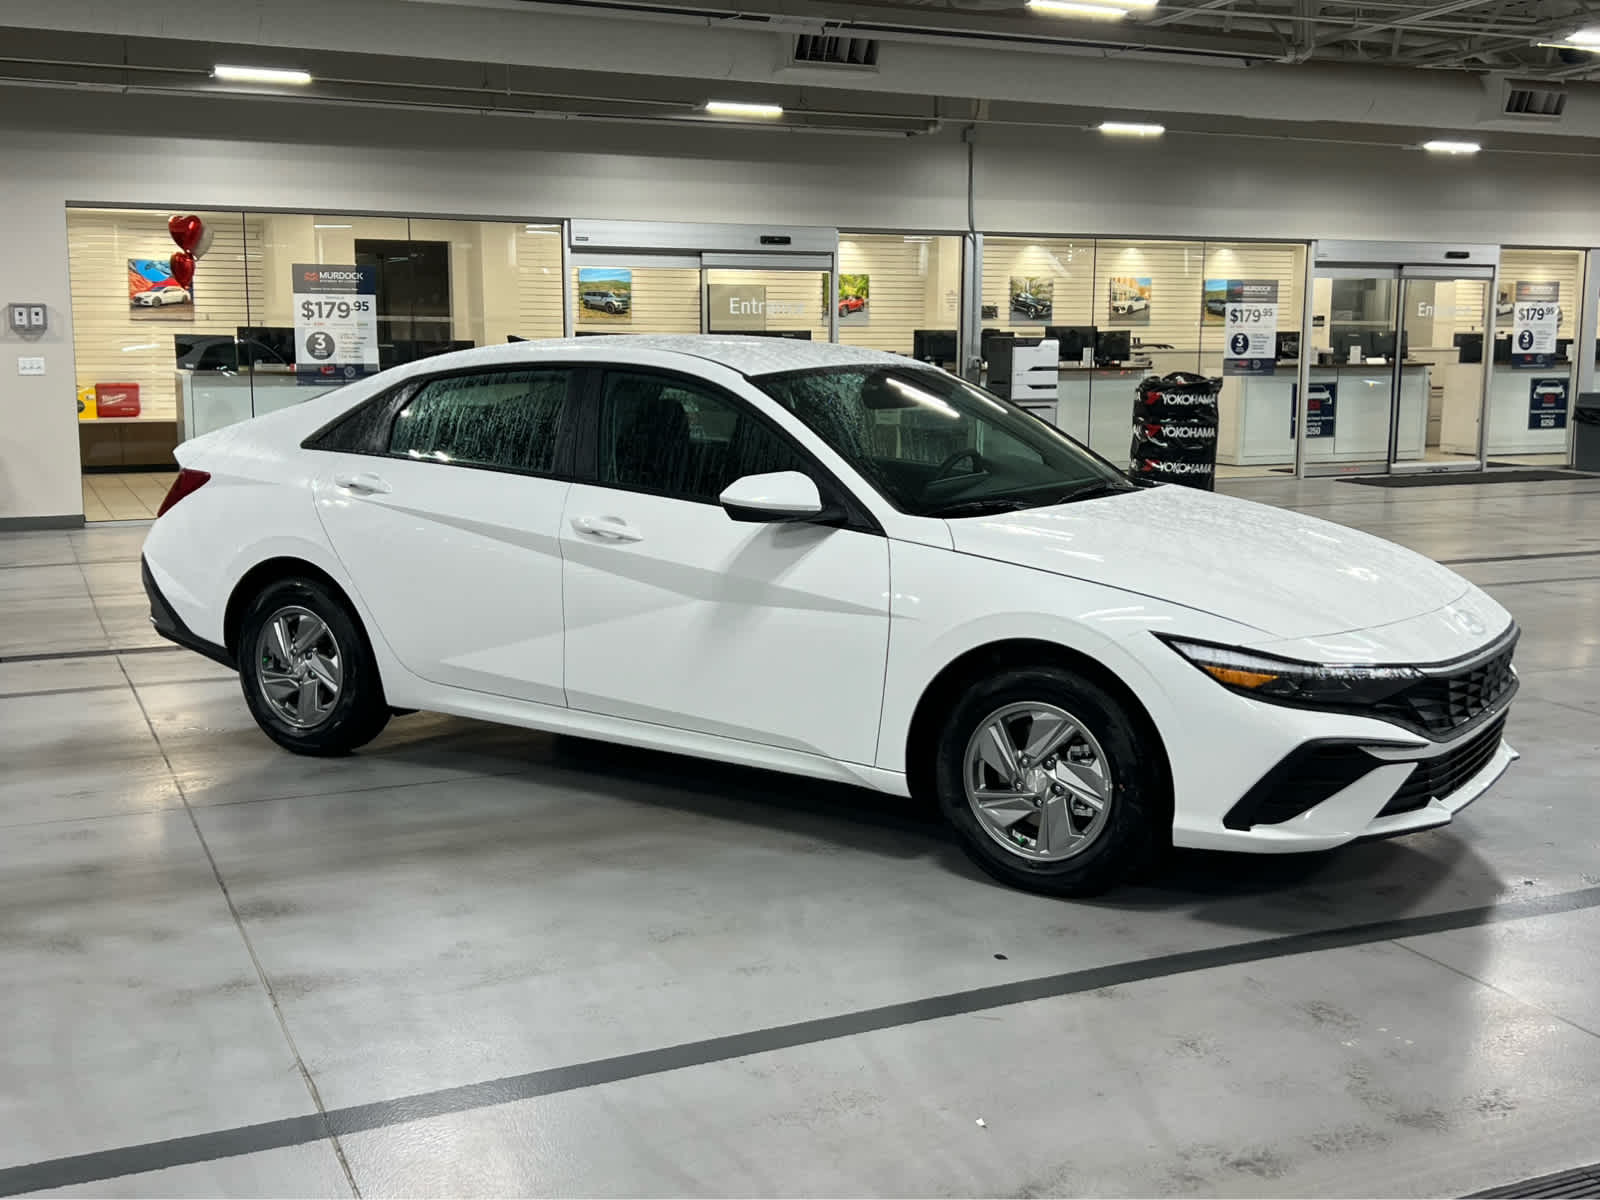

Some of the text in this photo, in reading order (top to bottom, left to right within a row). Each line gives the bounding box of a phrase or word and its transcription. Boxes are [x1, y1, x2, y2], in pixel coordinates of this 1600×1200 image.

[320, 272, 363, 280] MURDOCK
[314, 334, 326, 349] 3
[1236, 335, 1244, 346] 3
[1523, 331, 1530, 343] 3
[1162, 393, 1216, 405] YOKOHAMA
[1161, 426, 1216, 438] YOKOHAMA
[1160, 461, 1212, 473] YOKOHAMA
